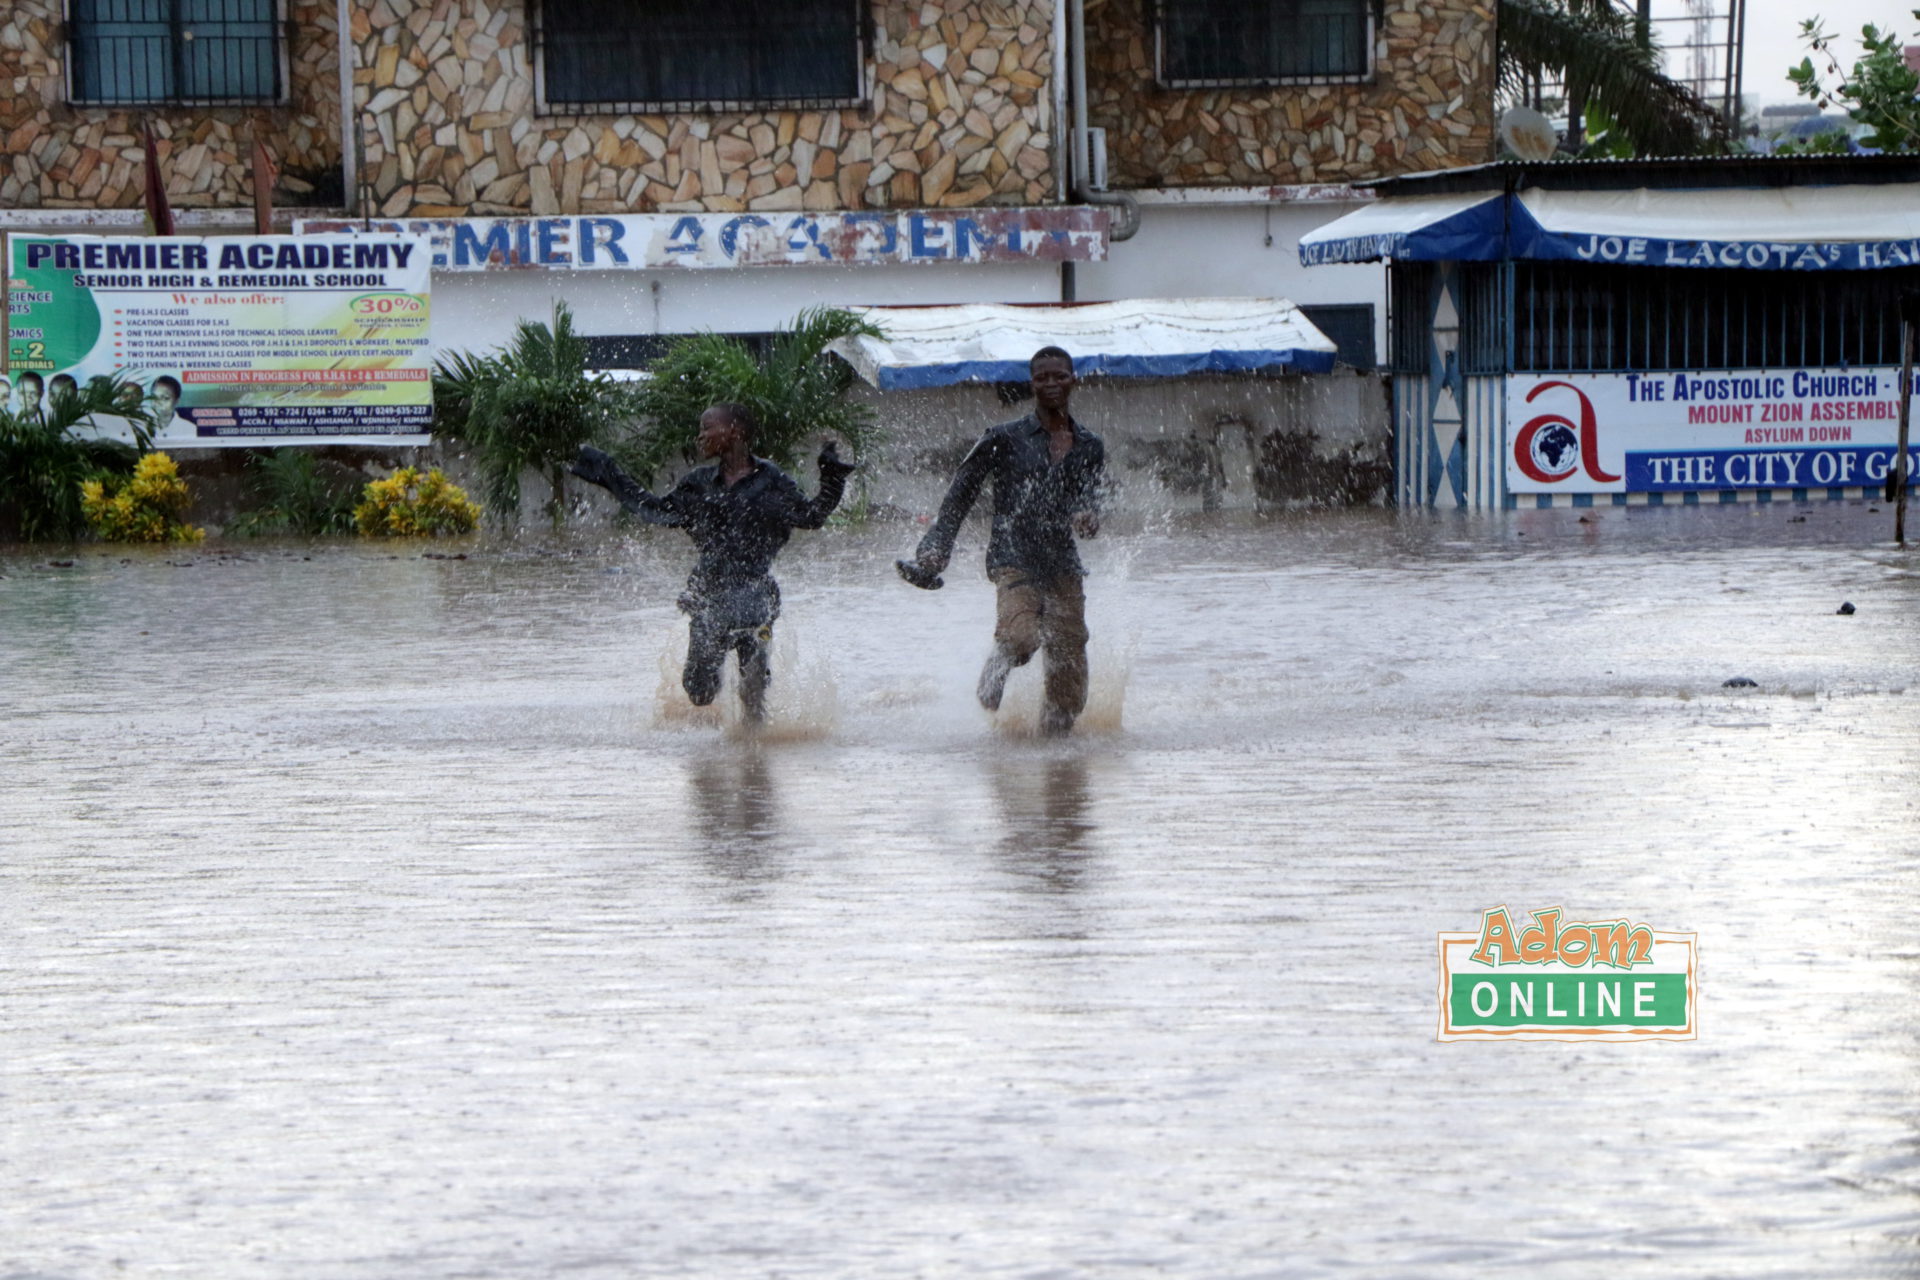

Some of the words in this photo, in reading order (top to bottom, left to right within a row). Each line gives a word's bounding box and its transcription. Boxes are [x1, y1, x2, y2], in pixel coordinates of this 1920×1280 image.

[1577, 235, 1648, 261] JOE
[26, 243, 208, 270] PREMIER
[219, 242, 414, 270] ACADEMY
[73, 274, 143, 288] SENIOR
[148, 274, 195, 288] HIGH
[199, 275, 212, 288] &
[219, 274, 311, 288] REMEDIAL
[314, 273, 386, 287] SCHOOL
[8, 292, 52, 302] CIENCE
[172, 293, 199, 305] We
[204, 293, 236, 305] also
[241, 293, 285, 305] offer:
[8, 304, 31, 313] RTS
[359, 297, 420, 314] 30%
[160, 308, 189, 316] CLASSES
[126, 319, 164, 327] VACATION
[166, 319, 195, 327] CLASSES
[196, 319, 211, 327] FOR
[237, 329, 276, 337] TECHNICAL
[278, 329, 306, 337] SCHOOL
[127, 340, 144, 348] TWO
[145, 340, 168, 348] YEARS
[188, 340, 220, 348] EVENING
[395, 338, 429, 346] MATURED
[28, 342, 45, 359] 2
[9, 360, 55, 370] EMEDIALS
[146, 361, 178, 369] EVENING
[223, 360, 252, 368] CLASSES
[187, 372, 238, 382] ADMISSION
[240, 372, 250, 381] IN
[252, 371, 300, 382] PROGRESS
[303, 371, 321, 380] FOR
[374, 370, 426, 380] REMEDIALS
[1688, 403, 1754, 425] MOUNT
[1761, 402, 1803, 422] ZION
[241, 418, 267, 426] ACCRA
[1745, 426, 1804, 443] ASYLUM
[1809, 426, 1852, 442] DOWN
[1648, 456, 1716, 484] THE
[1724, 452, 1805, 485] CITY
[1811, 451, 1857, 483] OF
[1865, 451, 1920, 480] GO
